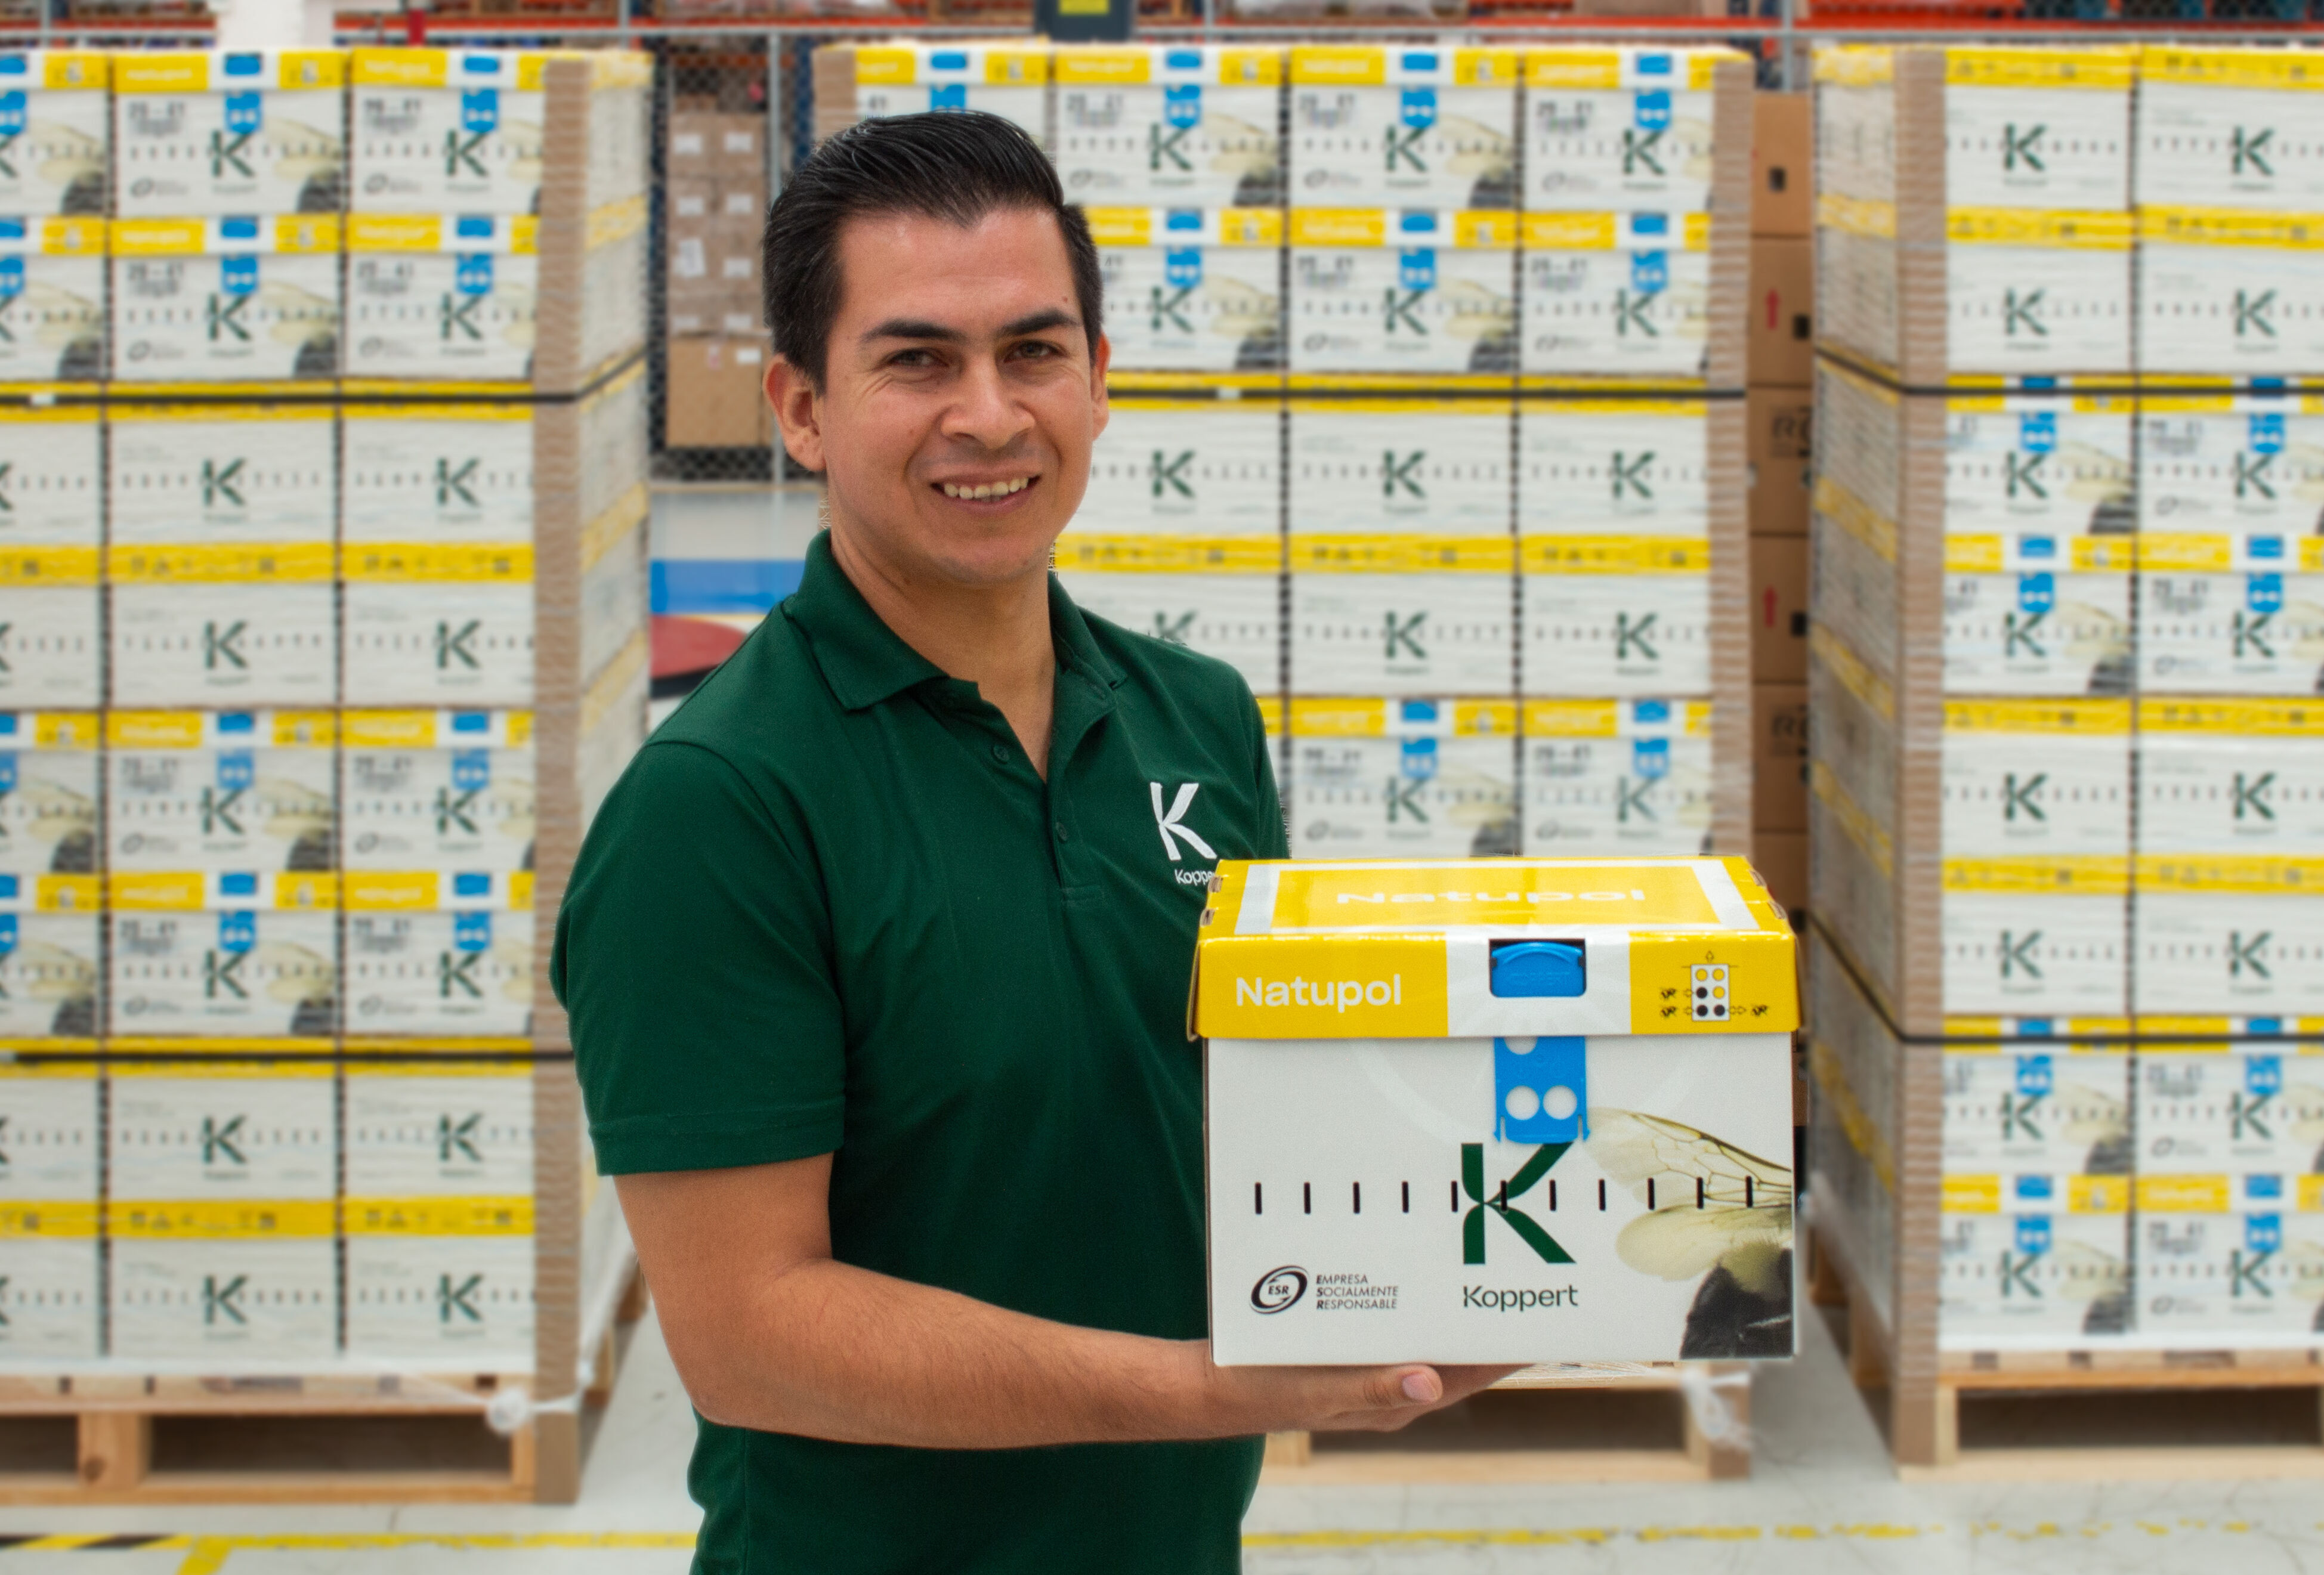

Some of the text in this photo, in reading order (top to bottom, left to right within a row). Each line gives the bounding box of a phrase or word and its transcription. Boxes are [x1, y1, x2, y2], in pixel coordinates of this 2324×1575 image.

[209, 129, 252, 178] K
[446, 129, 490, 177] K
[1149, 123, 1192, 170] K
[1384, 125, 1429, 172] K
[1623, 128, 1665, 174] K
[2005, 123, 2046, 171] K
[2233, 126, 2274, 175] K
[206, 293, 251, 341] K
[440, 293, 483, 340] K
[1149, 286, 1195, 332] K
[1384, 287, 1427, 335] K
[1616, 290, 1659, 336] K
[2006, 290, 2047, 336] K
[2236, 290, 2275, 336] K
[200, 458, 245, 506] K
[435, 458, 479, 506] K
[1151, 450, 1195, 497] K
[1383, 450, 1426, 497] K
[1612, 451, 1655, 499] K
[2007, 451, 2048, 499] K
[2236, 452, 2276, 499] K
[203, 621, 248, 670] K
[435, 620, 480, 669] K
[1384, 611, 1427, 659] K
[1617, 612, 1658, 660] K
[2005, 612, 2048, 658] K
[2234, 611, 2276, 658] K
[202, 787, 246, 834] K
[437, 787, 480, 834] K
[1386, 776, 1430, 823] K
[1618, 775, 1660, 822] K
[2005, 773, 2047, 821] K
[2235, 772, 2276, 820] K
[1150, 782, 1217, 861] K
[1175, 869, 1215, 886] Koppe
[1337, 889, 1645, 903] Natupol
[205, 951, 248, 998] K
[440, 951, 484, 998] K
[2002, 932, 2042, 978] K
[2232, 932, 2272, 978] K
[1236, 973, 1401, 1013] Natupol
[437, 1114, 482, 1162] K
[2002, 1093, 2044, 1139] K
[2233, 1093, 2273, 1140] K
[202, 1117, 246, 1165] K
[1461, 1141, 1577, 1265] K
[1268, 1285, 1290, 1295] ESR
[1316, 1274, 1368, 1285] EMPRESA
[1316, 1285, 1399, 1297] SOCIALMENTE
[2001, 1250, 2043, 1298] K
[2232, 1249, 2273, 1298] K
[203, 1277, 247, 1326] K
[438, 1276, 482, 1324] K
[1316, 1298, 1397, 1310] RESPONSABLE
[1463, 1285, 1578, 1312] Koppert
